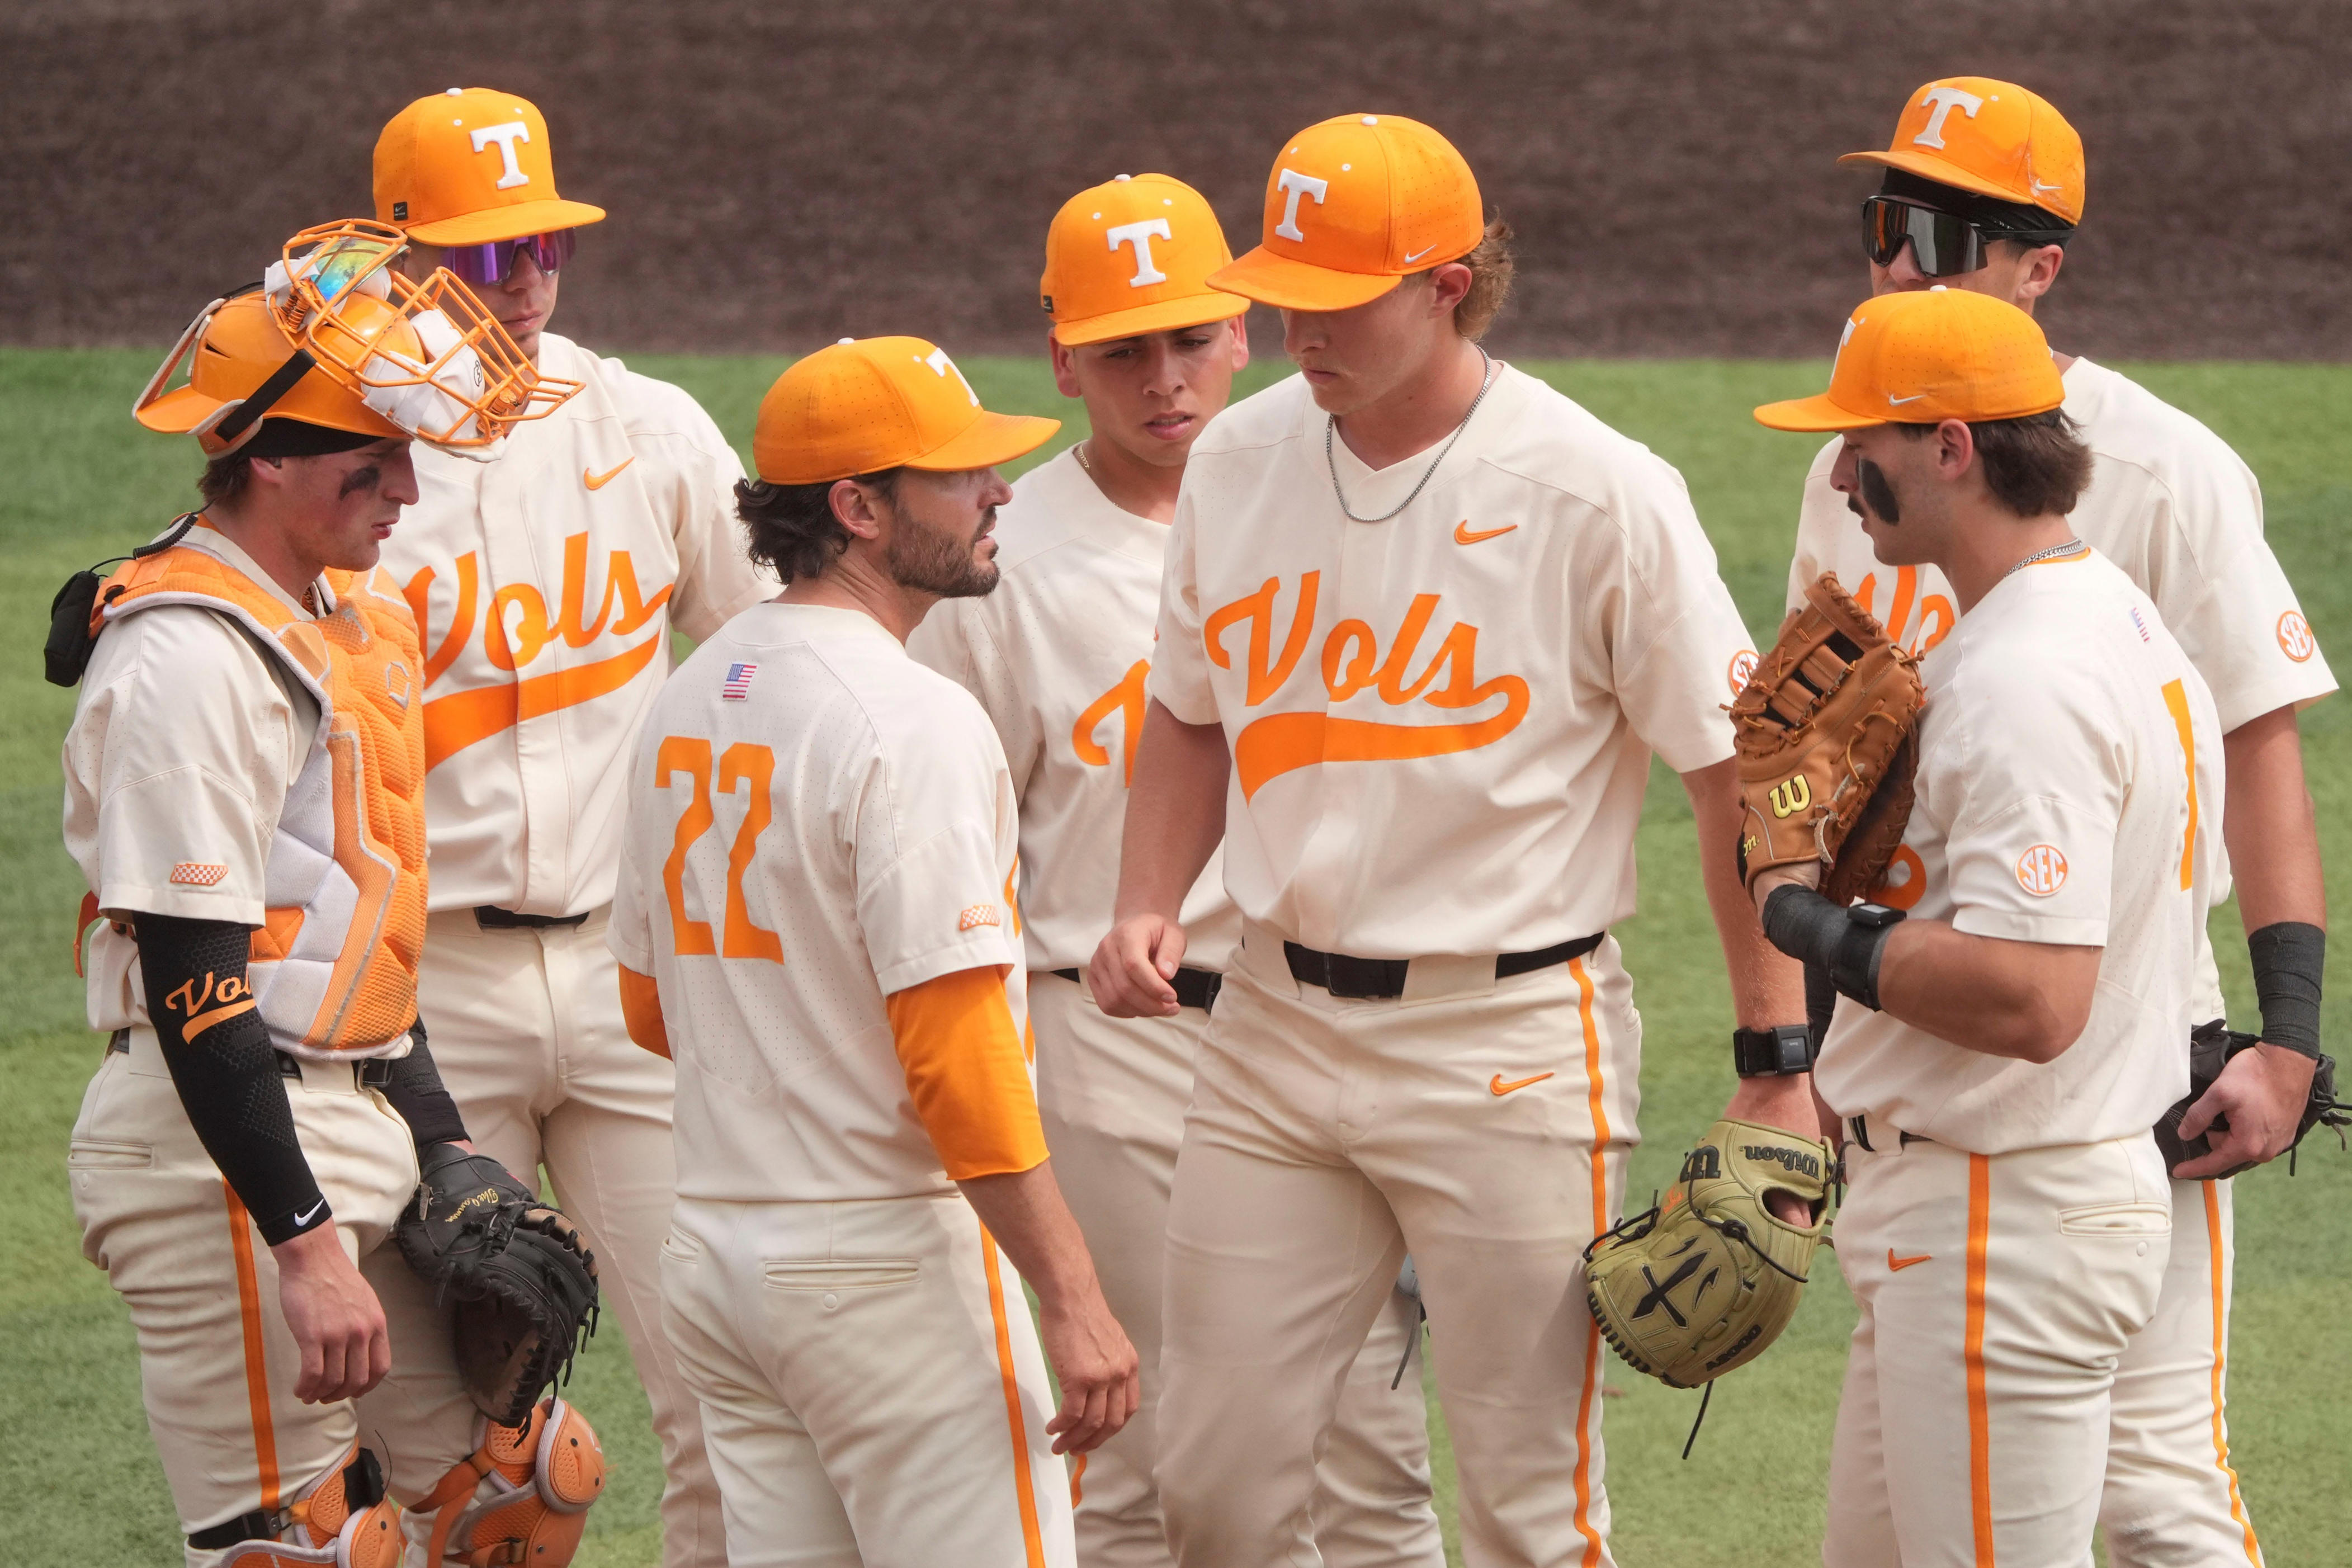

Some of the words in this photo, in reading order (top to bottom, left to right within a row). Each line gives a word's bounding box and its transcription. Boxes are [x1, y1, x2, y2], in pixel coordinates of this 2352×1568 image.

[1913, 87, 1983, 150] T
[470, 121, 530, 190] T
[1274, 168, 1329, 242] T
[1106, 218, 1172, 288] T
[402, 531, 674, 690] Vols
[1203, 569, 1481, 707] Vols
[2280, 613, 2312, 658] SEC
[1732, 653, 1759, 693] SE
[655, 735, 785, 965] 22
[2020, 847, 2065, 891] SEC
[165, 966, 252, 1017] Vol
[1744, 1145, 1819, 1180] Wilson
[477, 1188, 499, 1204] The
[1706, 1324, 1762, 1372] A2000
